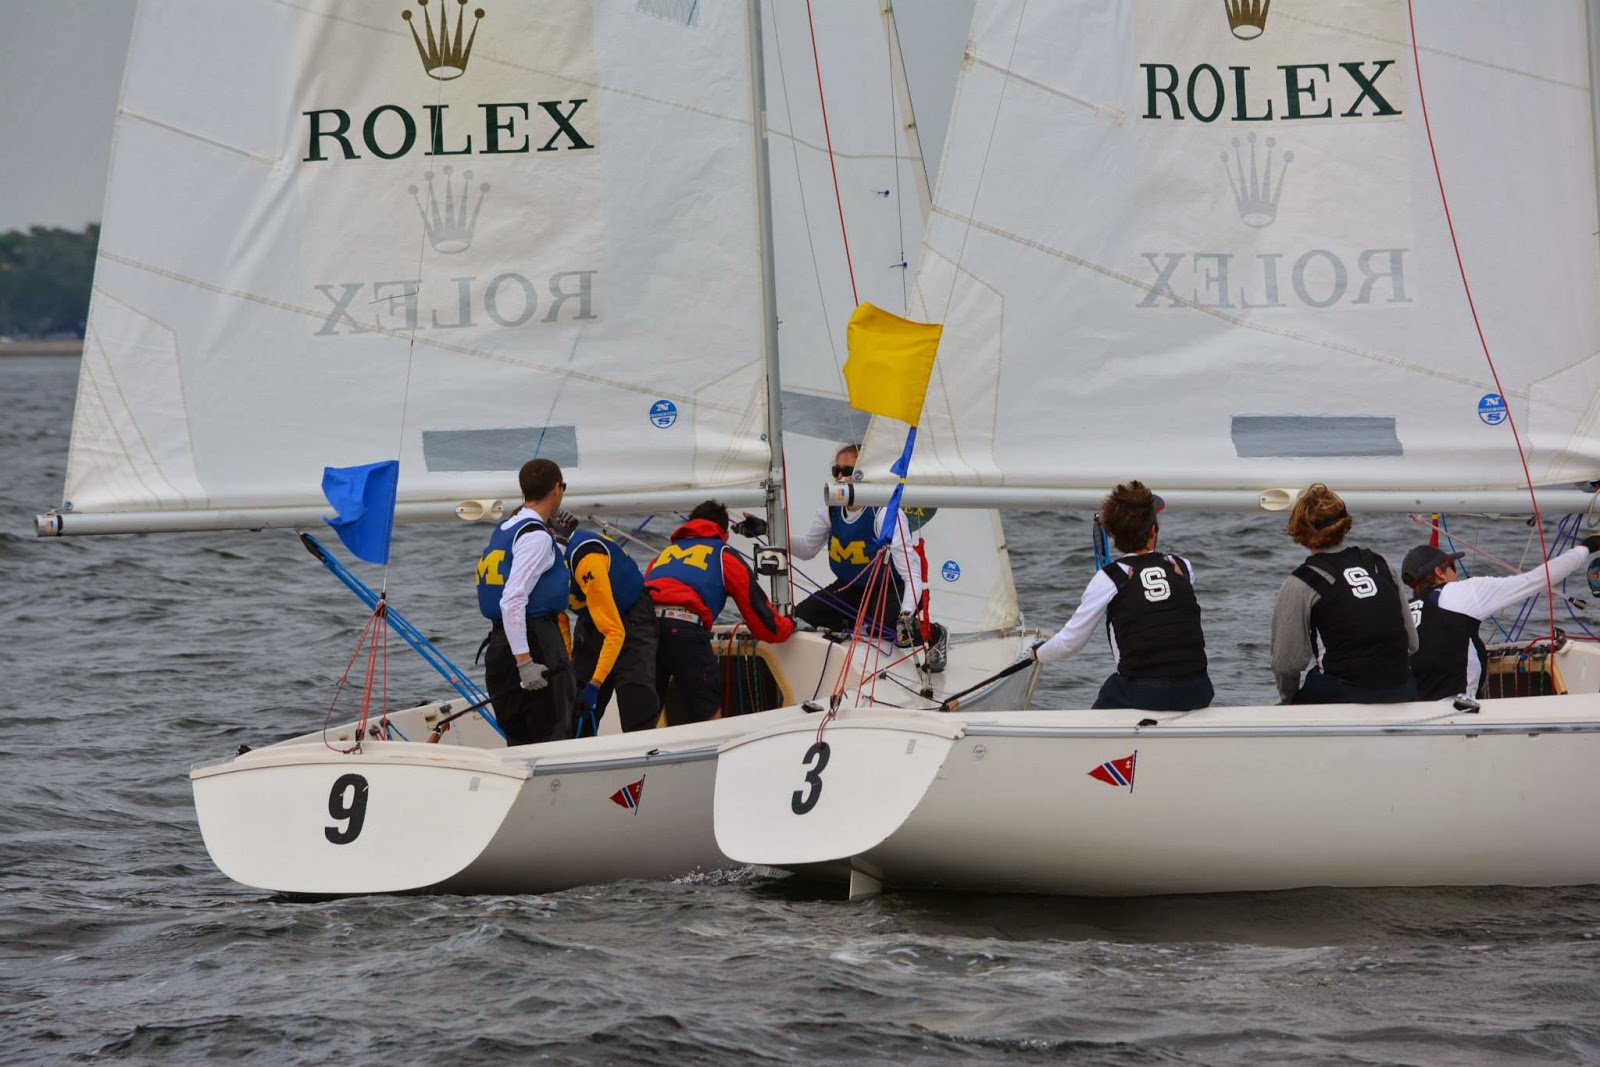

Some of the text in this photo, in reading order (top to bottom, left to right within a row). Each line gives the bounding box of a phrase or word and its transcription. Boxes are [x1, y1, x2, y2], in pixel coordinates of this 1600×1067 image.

[1139, 59, 1403, 123] ROLEX
[303, 98, 595, 162] ROLEX
[655, 402, 671, 412] N
[1484, 397, 1501, 406] N
[475, 549, 506, 586] M
[651, 544, 713, 571] M
[829, 536, 870, 566] M
[1139, 566, 1171, 602] S
[1342, 566, 1379, 599] S
[791, 741, 831, 815] 3
[325, 773, 369, 845] 9
